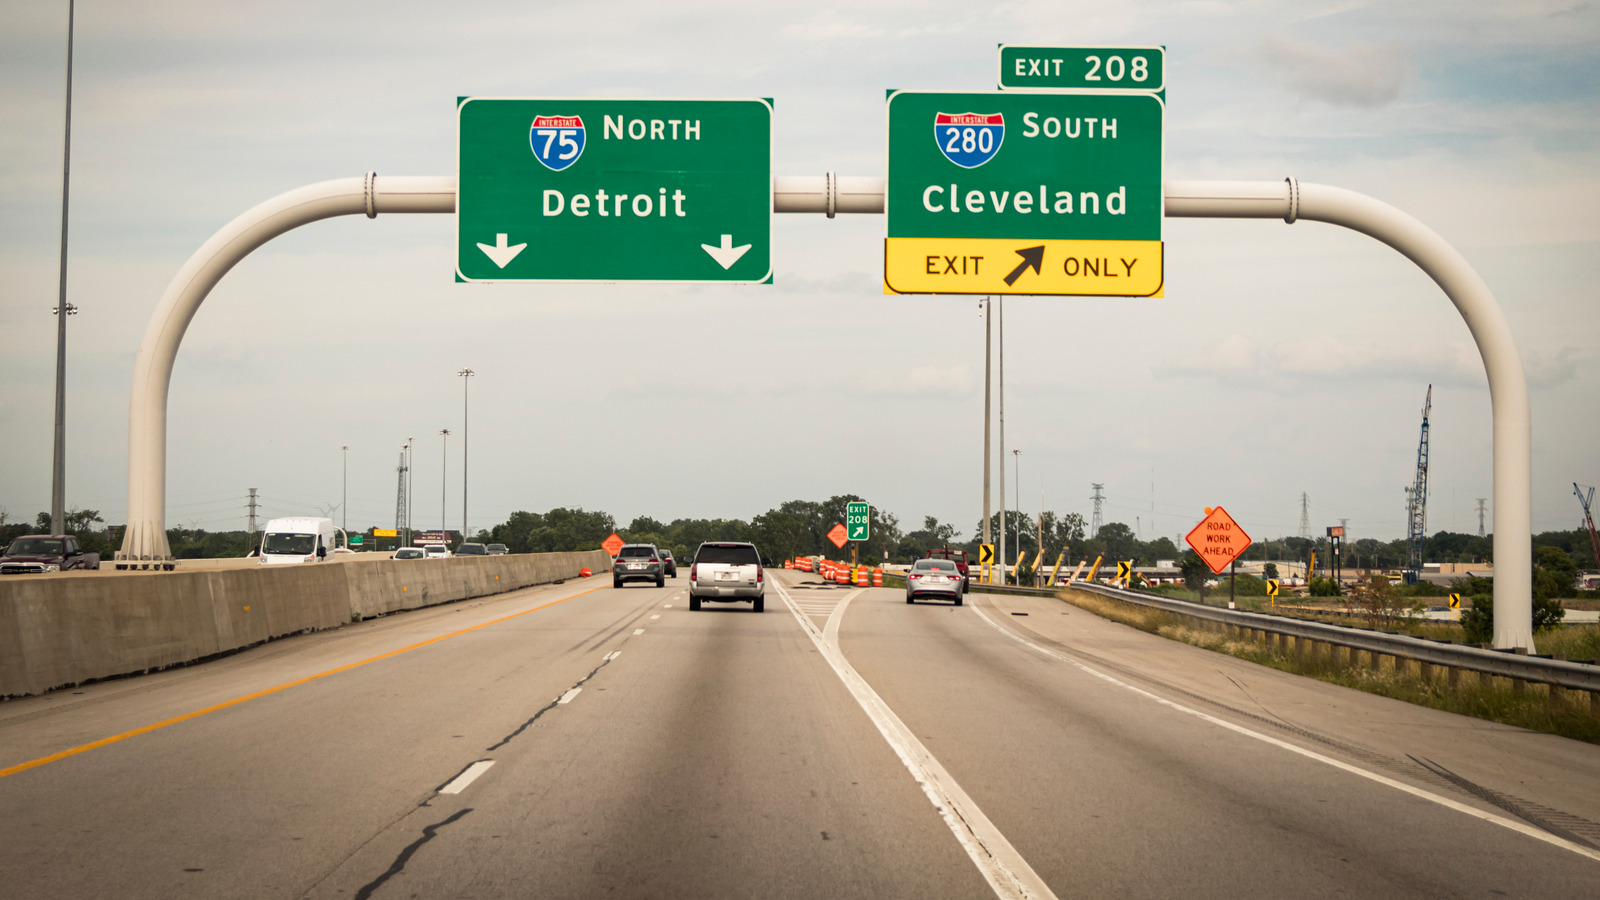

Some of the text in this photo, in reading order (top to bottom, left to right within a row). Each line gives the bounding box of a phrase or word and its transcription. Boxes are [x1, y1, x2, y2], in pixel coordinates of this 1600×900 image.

[1016, 56, 1148, 81] EXIT 208
[538, 118, 577, 127] INTERSTATE
[604, 115, 700, 140] NORTH
[950, 116, 988, 124] INTERSTATE
[1023, 112, 1117, 138] SOUTH
[537, 130, 579, 160] 75
[945, 127, 993, 153] 280
[543, 188, 686, 217] Detroit
[923, 184, 1126, 215] Cleveland
[926, 256, 1137, 277] EXIT ONLY
[849, 515, 868, 524] 208
[1207, 522, 1231, 531] ROAD
[1206, 534, 1231, 543] WORK
[1203, 546, 1234, 556] AHEAD
